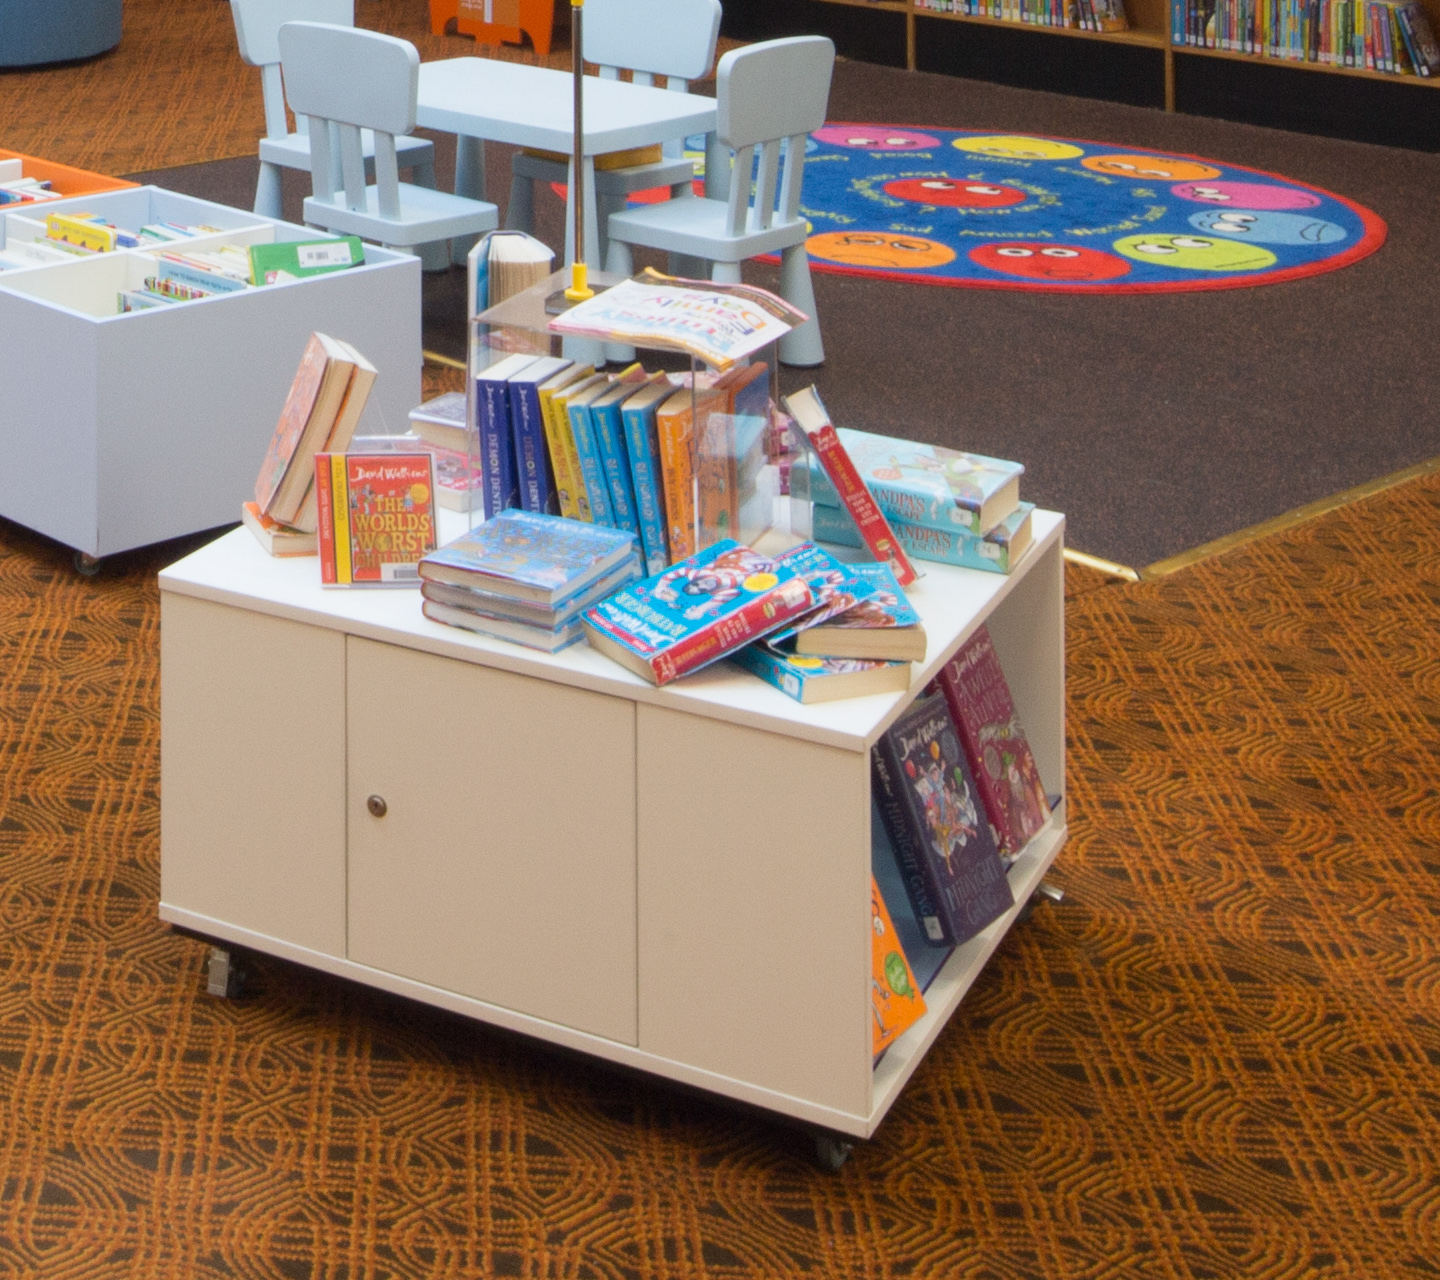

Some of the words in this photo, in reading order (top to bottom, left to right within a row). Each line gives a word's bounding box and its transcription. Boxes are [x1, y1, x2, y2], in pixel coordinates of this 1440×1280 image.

[485, 432, 505, 476] DEMON
[374, 497, 406, 513] THE
[873, 488, 926, 515] ANDPA'S
[355, 531, 430, 552] WORST
[892, 524, 951, 549] RANDPA'S
